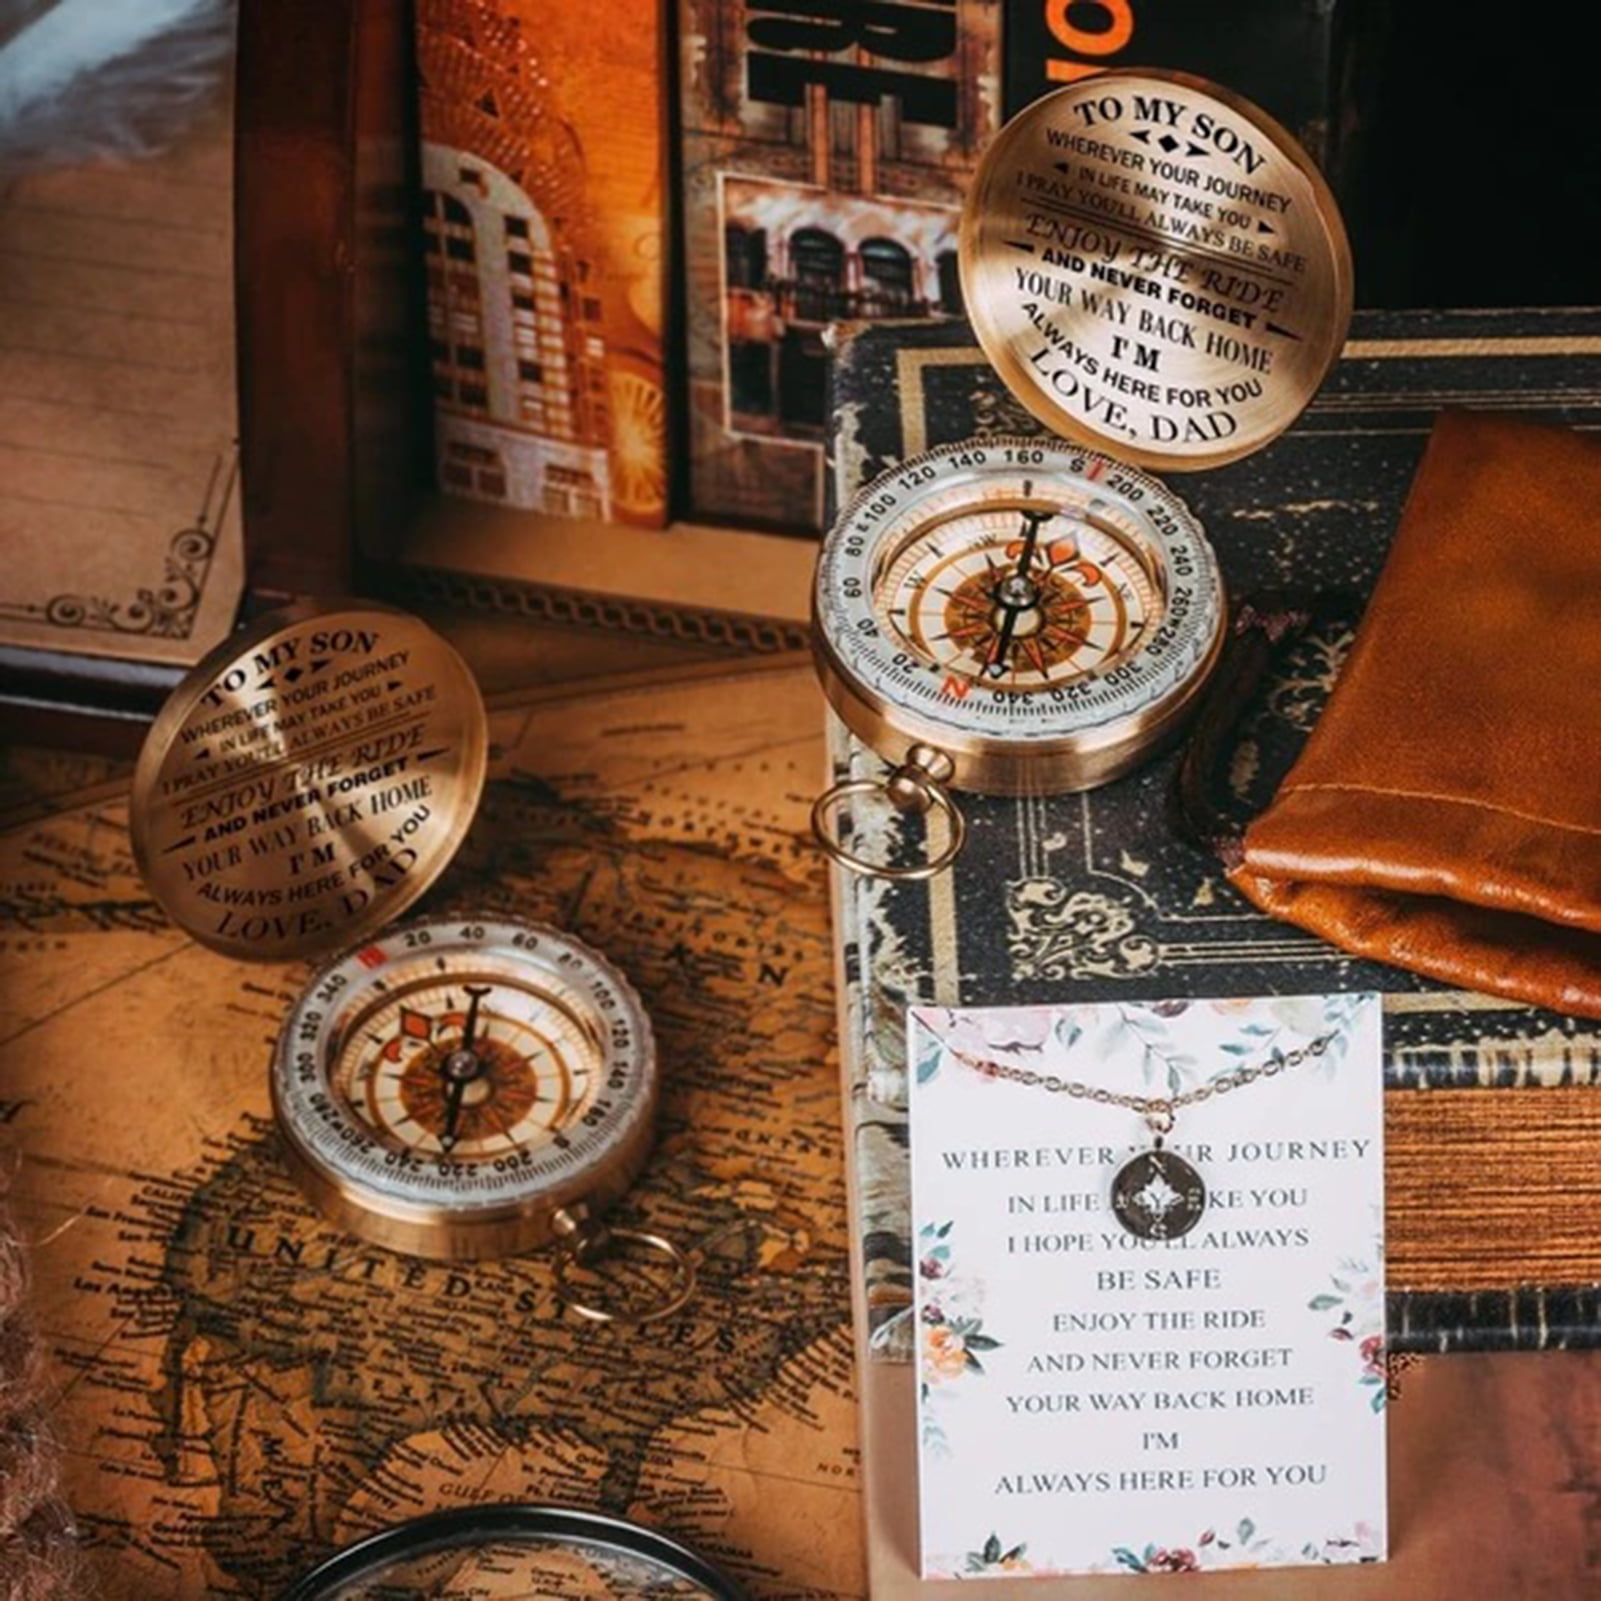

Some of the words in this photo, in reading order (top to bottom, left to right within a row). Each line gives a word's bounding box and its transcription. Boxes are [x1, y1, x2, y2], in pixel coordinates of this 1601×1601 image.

[1074, 96, 1122, 127] TO
[1133, 96, 1187, 127] MY
[1191, 113, 1266, 175] SON
[1046, 128, 1145, 171] WHEREVER
[1149, 157, 1199, 186] YOUR
[1203, 174, 1292, 213] JOURNEY
[1078, 166, 1097, 183] IN
[1100, 171, 1130, 194] LIFE
[1134, 181, 1171, 206] MAY
[1173, 192, 1213, 219] TAKE
[1217, 206, 1251, 229] YOU
[1017, 171, 1024, 186] I
[1026, 174, 1074, 199] PRAY
[1078, 189, 1140, 222] YOU'LL
[1145, 207, 1226, 248] ALWAYS
[1229, 236, 1255, 255] BE
[1257, 244, 1306, 273] SAFE
[1026, 211, 1122, 259] ENJOY
[1129, 243, 1198, 285] THE
[1203, 264, 1285, 314] RIDE
[1041, 248, 1085, 275] AND
[1090, 263, 1162, 299] NEVER
[1167, 288, 1258, 331] FORGET
[1015, 267, 1073, 304] YOUR
[1079, 289, 1132, 325] WAY
[1138, 308, 1197, 349] BACK
[1205, 330, 1274, 376] HOME
[1022, 302, 1099, 376] ALWAYS
[1103, 368, 1160, 403] HERE
[1166, 386, 1211, 408] FOR
[1216, 377, 1264, 406] YOU
[1111, 335, 1160, 373] I'M
[1030, 347, 1138, 440] LOVE,
[1151, 409, 1239, 444] DAD
[949, 450, 987, 469] 140
[1004, 451, 1044, 464] 160
[898, 466, 937, 490] 120
[1106, 474, 1144, 501] 200
[864, 494, 897, 523] 100
[1146, 505, 1178, 537] 220
[845, 535, 865, 557] 80
[1170, 545, 1192, 576] 240
[843, 577, 862, 598] 60
[1171, 585, 1193, 618] 260
[856, 618, 879, 639] 40
[200, 668, 248, 709] TO
[254, 636, 302, 677] MY
[308, 629, 380, 661] SON
[892, 653, 920, 674] 20
[180, 697, 278, 744] WHEREVER
[281, 679, 329, 708] YOUR
[332, 650, 410, 694] JOURNEY
[219, 735, 238, 753] IN
[274, 712, 307, 734] MAY
[310, 698, 349, 723] TAKE
[352, 685, 382, 708] YOU
[172, 764, 219, 794] PRAY
[289, 715, 364, 750] ALWAYS
[365, 703, 392, 725] BE
[393, 685, 437, 714] SAFE
[181, 780, 276, 830] ENJOY
[284, 754, 345, 792] THE
[350, 724, 426, 764] RIDE
[204, 815, 248, 843] AND
[253, 790, 323, 829] NEVER
[328, 756, 409, 798] FORGET
[182, 844, 242, 883] YOUR
[249, 826, 298, 858] WAY
[307, 805, 363, 838] BACK
[370, 775, 433, 815] HOME
[198, 880, 283, 906] ALWAYS
[288, 872, 345, 902] HERE
[349, 846, 390, 878] FOR
[391, 805, 431, 846] YOU
[288, 841, 337, 876] I'M
[344, 847, 419, 914] DAD
[942, 1147, 1116, 1169] WHEREVER
[1227, 1139, 1371, 1162] JOURNEY
[1008, 1196, 1036, 1213] IN
[1044, 1193, 1100, 1212] LIFE
[1249, 1188, 1308, 1207] YOU
[1008, 1236, 1015, 1253] I
[1024, 1233, 1093, 1252] HOPE
[1100, 1232, 1196, 1250] YOULL
[1202, 1228, 1310, 1249] ALWAYS
[1097, 1270, 1134, 1291] BE
[1144, 1269, 1221, 1290] SAFE
[1053, 1312, 1137, 1332] ENJOY
[1144, 1311, 1196, 1330] THE
[1203, 1310, 1266, 1329] RIDE
[1028, 1353, 1085, 1372] AND
[1092, 1351, 1181, 1371] NEVER
[1189, 1348, 1293, 1369] FORGET
[1006, 1394, 1082, 1413] YOUR
[1089, 1392, 1147, 1411] WAY
[1154, 1391, 1227, 1410] BACK
[1236, 1387, 1315, 1407] HOME
[1142, 1432, 1179, 1450] I'M
[995, 1473, 1112, 1494] ALWAYS
[1119, 1470, 1195, 1491] HERE
[1203, 1467, 1257, 1488] FOR
[1265, 1464, 1328, 1486] YOU
